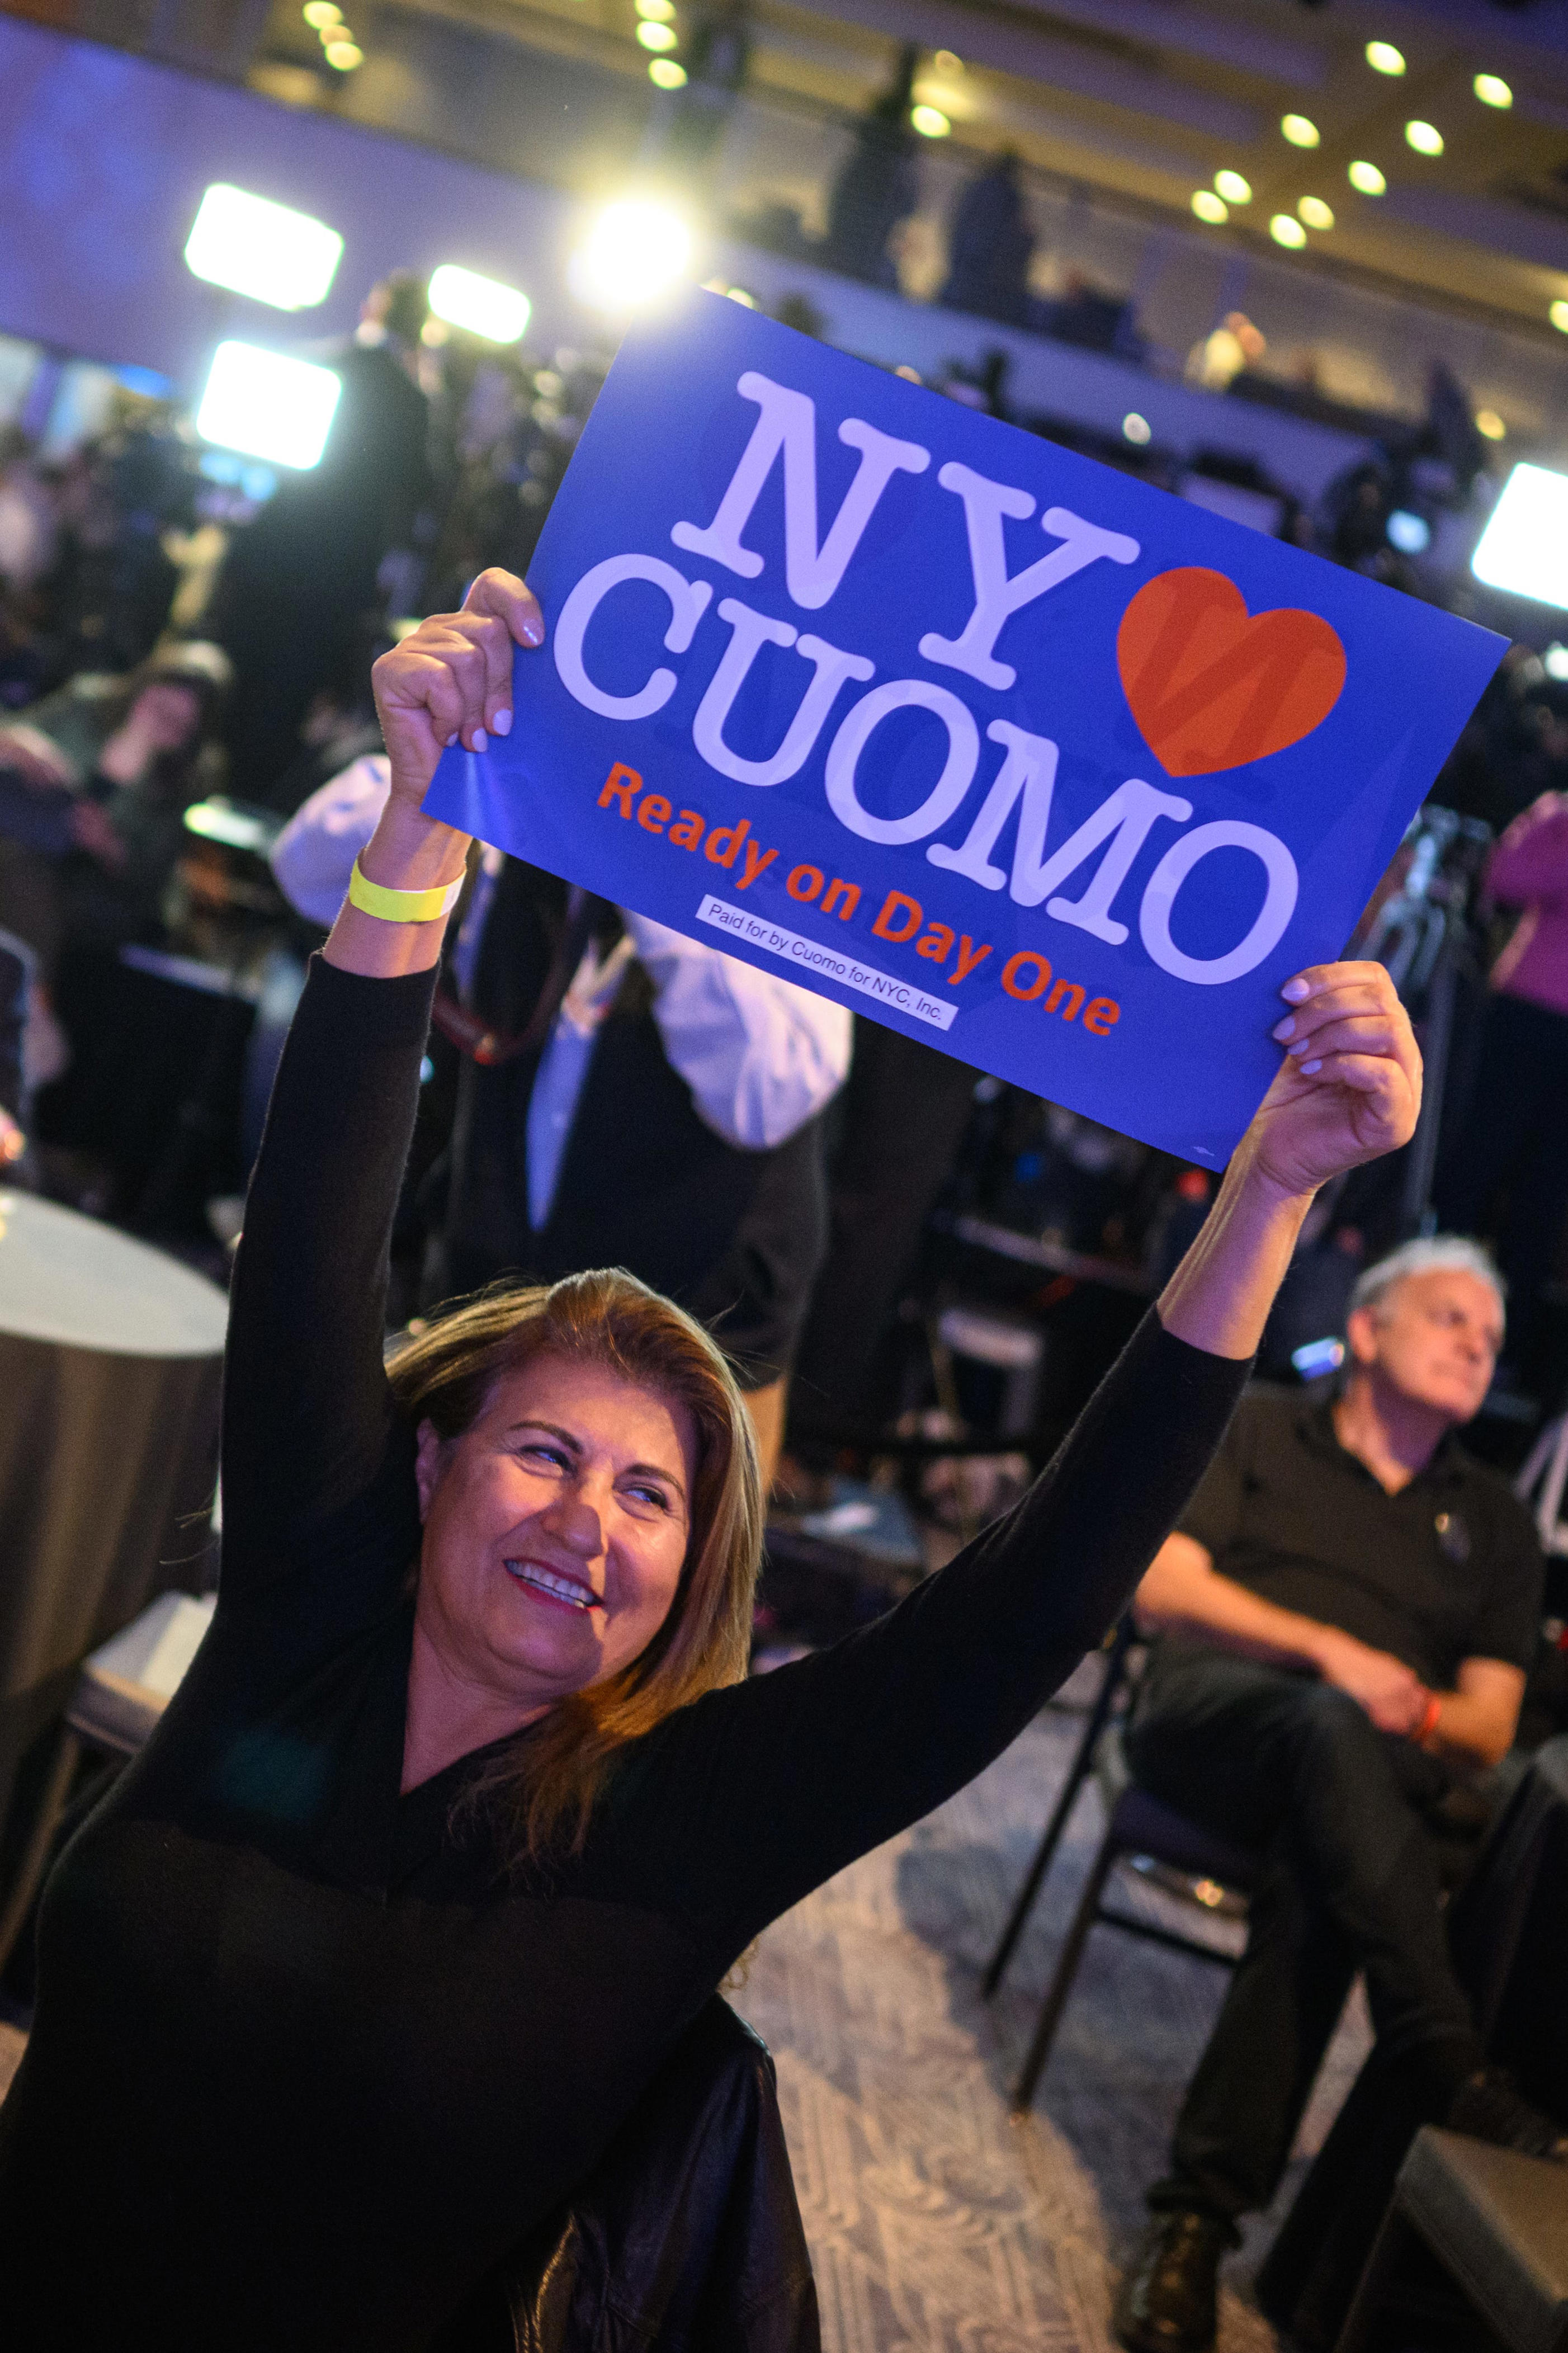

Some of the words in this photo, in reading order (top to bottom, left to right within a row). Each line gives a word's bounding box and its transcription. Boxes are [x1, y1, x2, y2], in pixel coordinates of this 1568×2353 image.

[670, 371, 1140, 690] NY
[554, 553, 1298, 985] CUOMO
[597, 762, 780, 890] Ready
[786, 864, 862, 921] on
[871, 890, 993, 985] Day
[1001, 950, 1121, 1036] One
[708, 903, 745, 930] Paid
[745, 920, 768, 939] for
[768, 931, 789, 951] by
[791, 941, 846, 975] Cuomo
[848, 966, 871, 985] for
[871, 977, 910, 1008] NYC,
[915, 997, 942, 1020] Inc.
